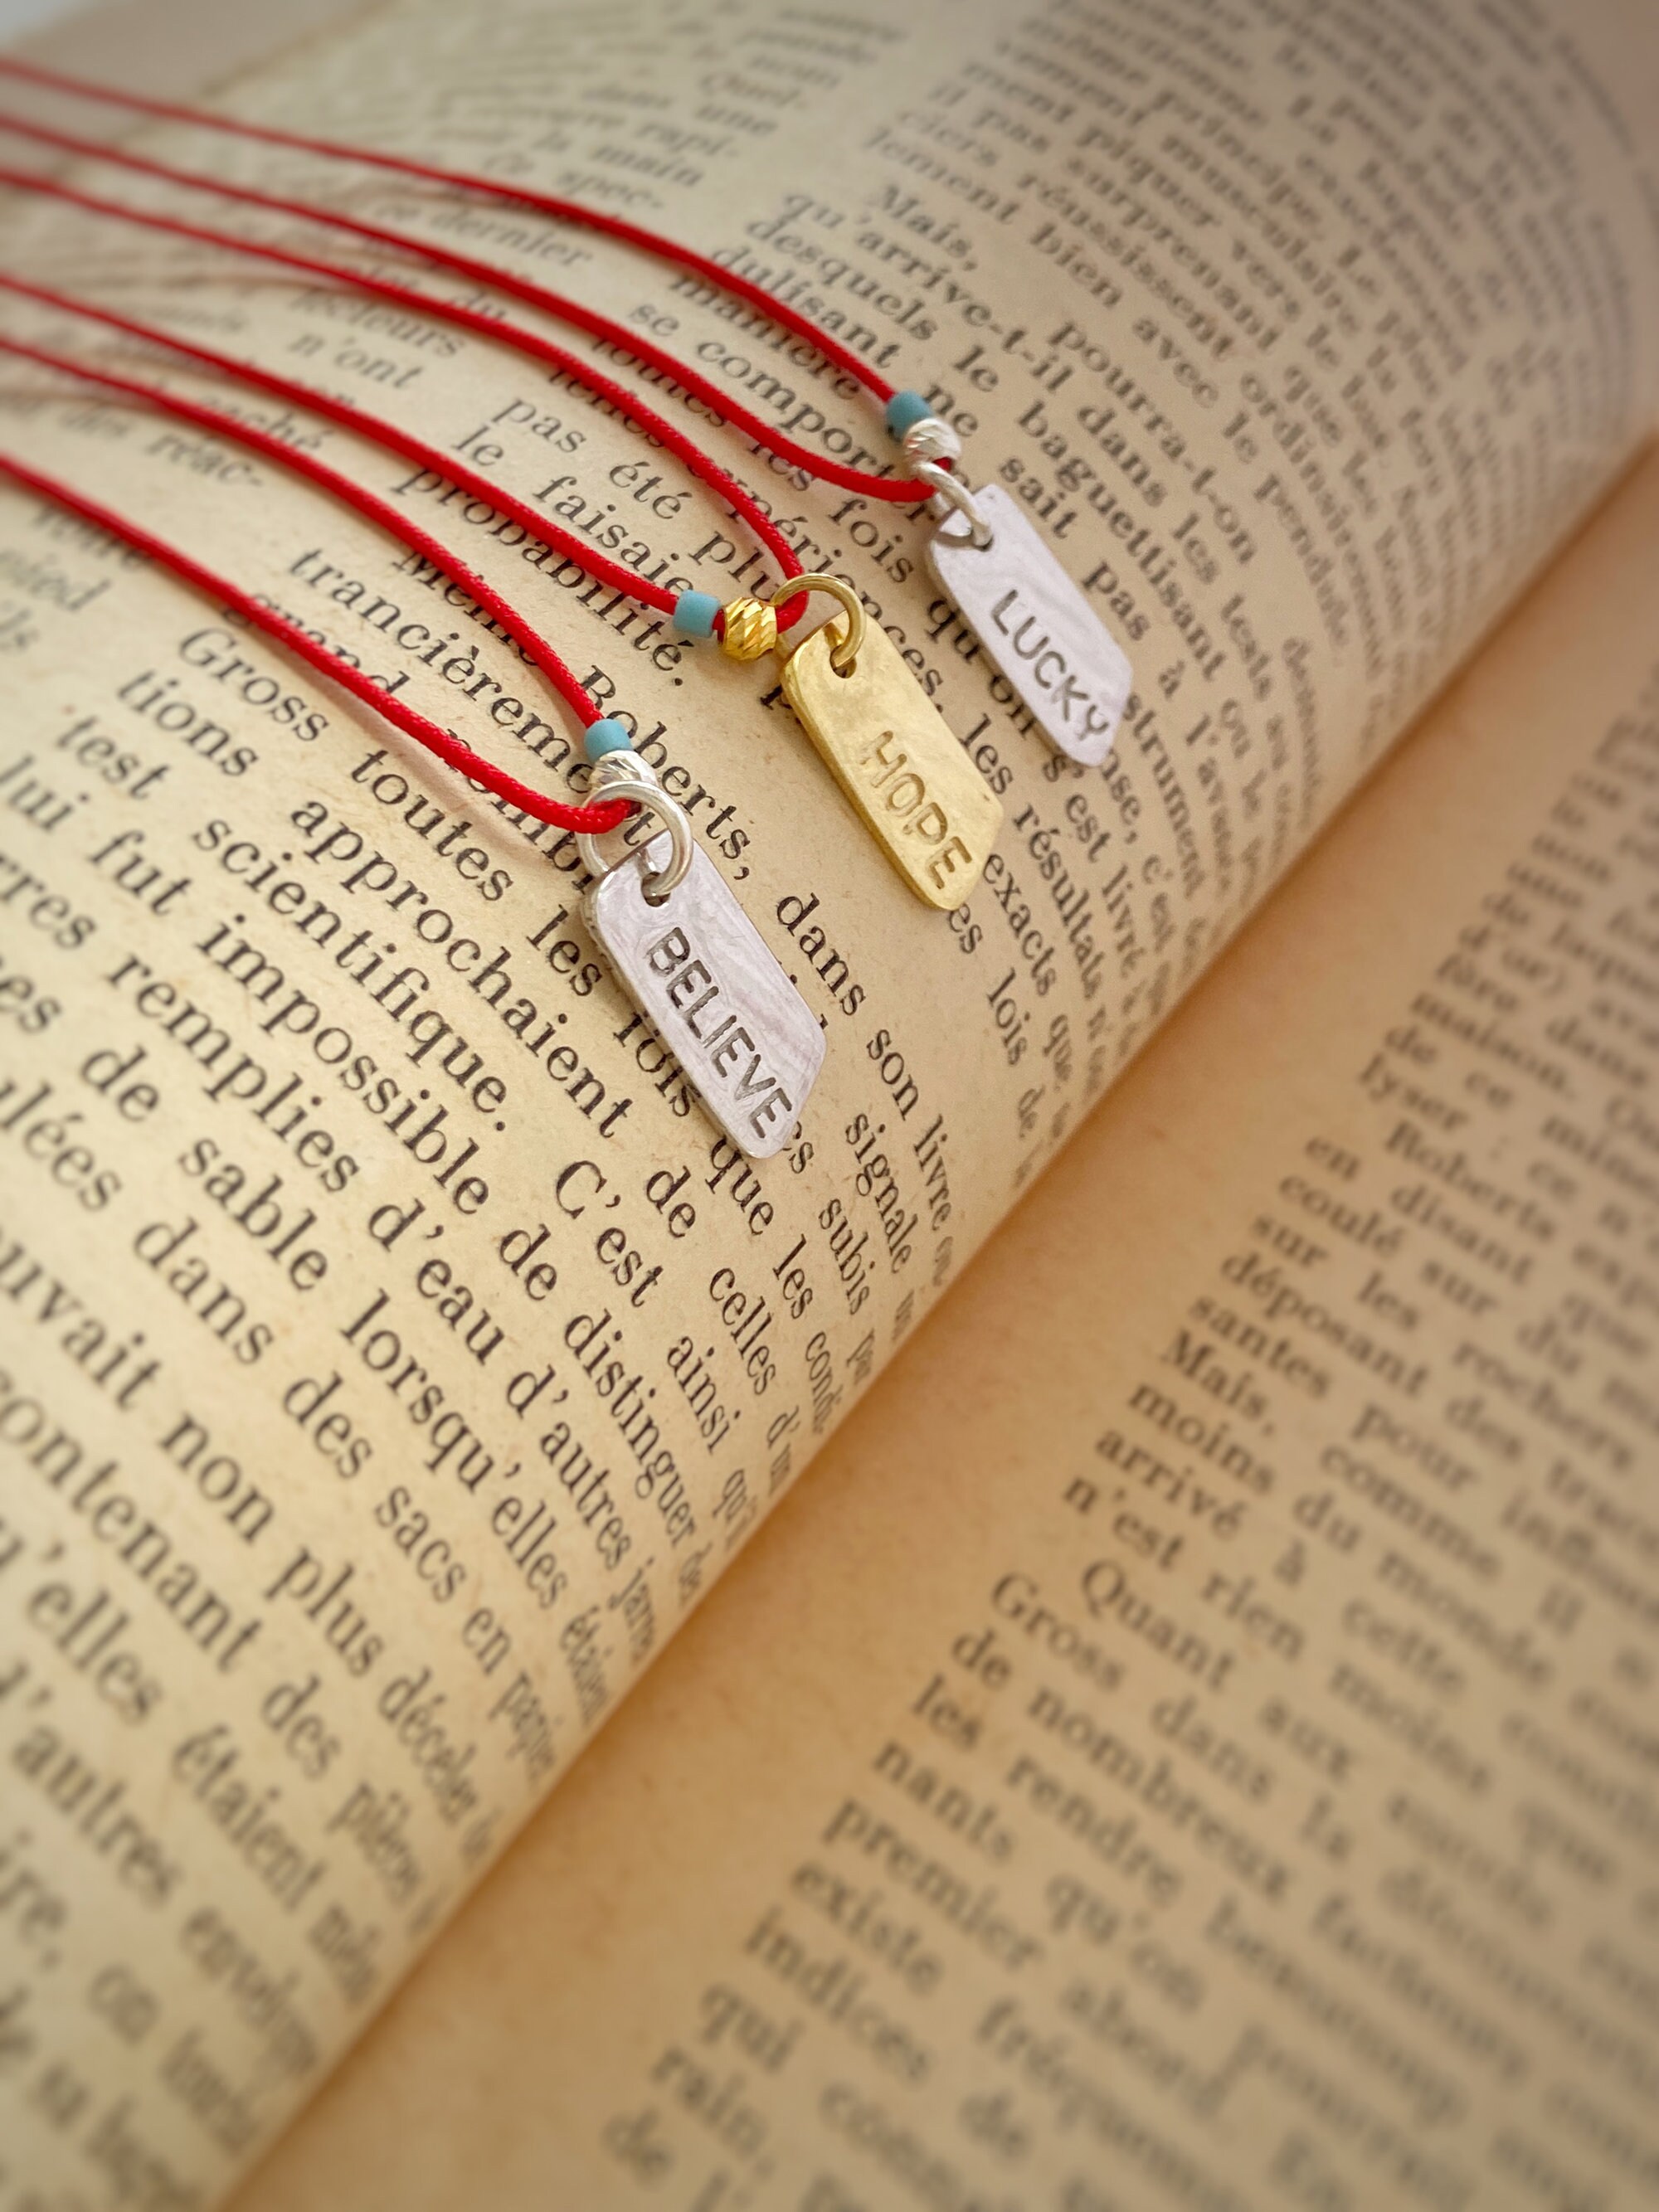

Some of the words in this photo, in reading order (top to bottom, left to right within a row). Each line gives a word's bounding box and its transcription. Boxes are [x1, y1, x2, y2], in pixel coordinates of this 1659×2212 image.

[882, 183, 977, 272] Mais,
[628, 304, 681, 338] se
[746, 217, 938, 341] desquels
[954, 345, 999, 392] le
[1018, 400, 1227, 683] baguettisant
[1078, 406, 1167, 507] dans
[830, 498, 913, 584] fois
[1000, 457, 1078, 541] sait
[1082, 561, 1151, 642] pas
[450, 421, 504, 468] le
[987, 967, 1032, 1067] lois
[490, 398, 588, 454] pas
[609, 460, 693, 519] été
[982, 853, 1058, 998] exacts
[990, 588, 1111, 741] LUCKY
[859, 729, 974, 892] HOPE
[960, 713, 1014, 795] les
[1013, 803, 1102, 999] résultats
[117, 669, 260, 777] tions
[291, 800, 634, 1139] approchaient
[645, 1164, 697, 1238] de
[709, 1267, 776, 1395] celles
[178, 626, 330, 743] Gross
[350, 749, 513, 902] toutes
[526, 903, 604, 997] les
[706, 1137, 776, 1236] que
[772, 1233, 813, 1319] les
[647, 926, 795, 1140] BELIEVE
[58, 716, 171, 802] test
[192, 818, 508, 1131] scientifique.
[555, 1159, 664, 1308] C'est
[667, 1334, 741, 1455] ainsi
[776, 892, 865, 1016] dans
[865, 1028, 920, 1163] son
[913, 1114, 952, 1232] livre
[0, 755, 90, 832] lui
[89, 829, 192, 916] fut
[195, 913, 489, 1216] impossible
[499, 1223, 557, 1301] de
[564, 1308, 695, 1548] distinguer
[845, 1113, 917, 1276] signale
[80, 1045, 159, 1122] de
[178, 1137, 328, 1292] sable
[339, 1287, 569, 1610] lorsqu'elles
[105, 954, 360, 1193] remplies
[367, 1198, 505, 1366] d'eau
[506, 1364, 632, 1571] d'autres
[819, 1198, 875, 1315] subis
[133, 1216, 274, 1365] dans
[283, 1370, 372, 1479] des
[375, 1485, 467, 1604] sacs
[461, 1606, 512, 1677] en
[1126, 1381, 1275, 1494] moins
[1160, 1329, 1277, 1440] Mais,
[158, 1412, 275, 1544] non
[264, 1545, 384, 1677] plus
[1062, 1475, 1185, 1571] n'est
[1093, 1427, 1248, 1539] arrivé
[0, 1367, 262, 1675] ontenant
[260, 1673, 340, 1782] des
[990, 1571, 1125, 1693] Gross
[1082, 1557, 1236, 1693] Quant
[912, 1672, 984, 1753] les
[951, 1626, 1014, 1690] de
[873, 1738, 1019, 1866] nants
